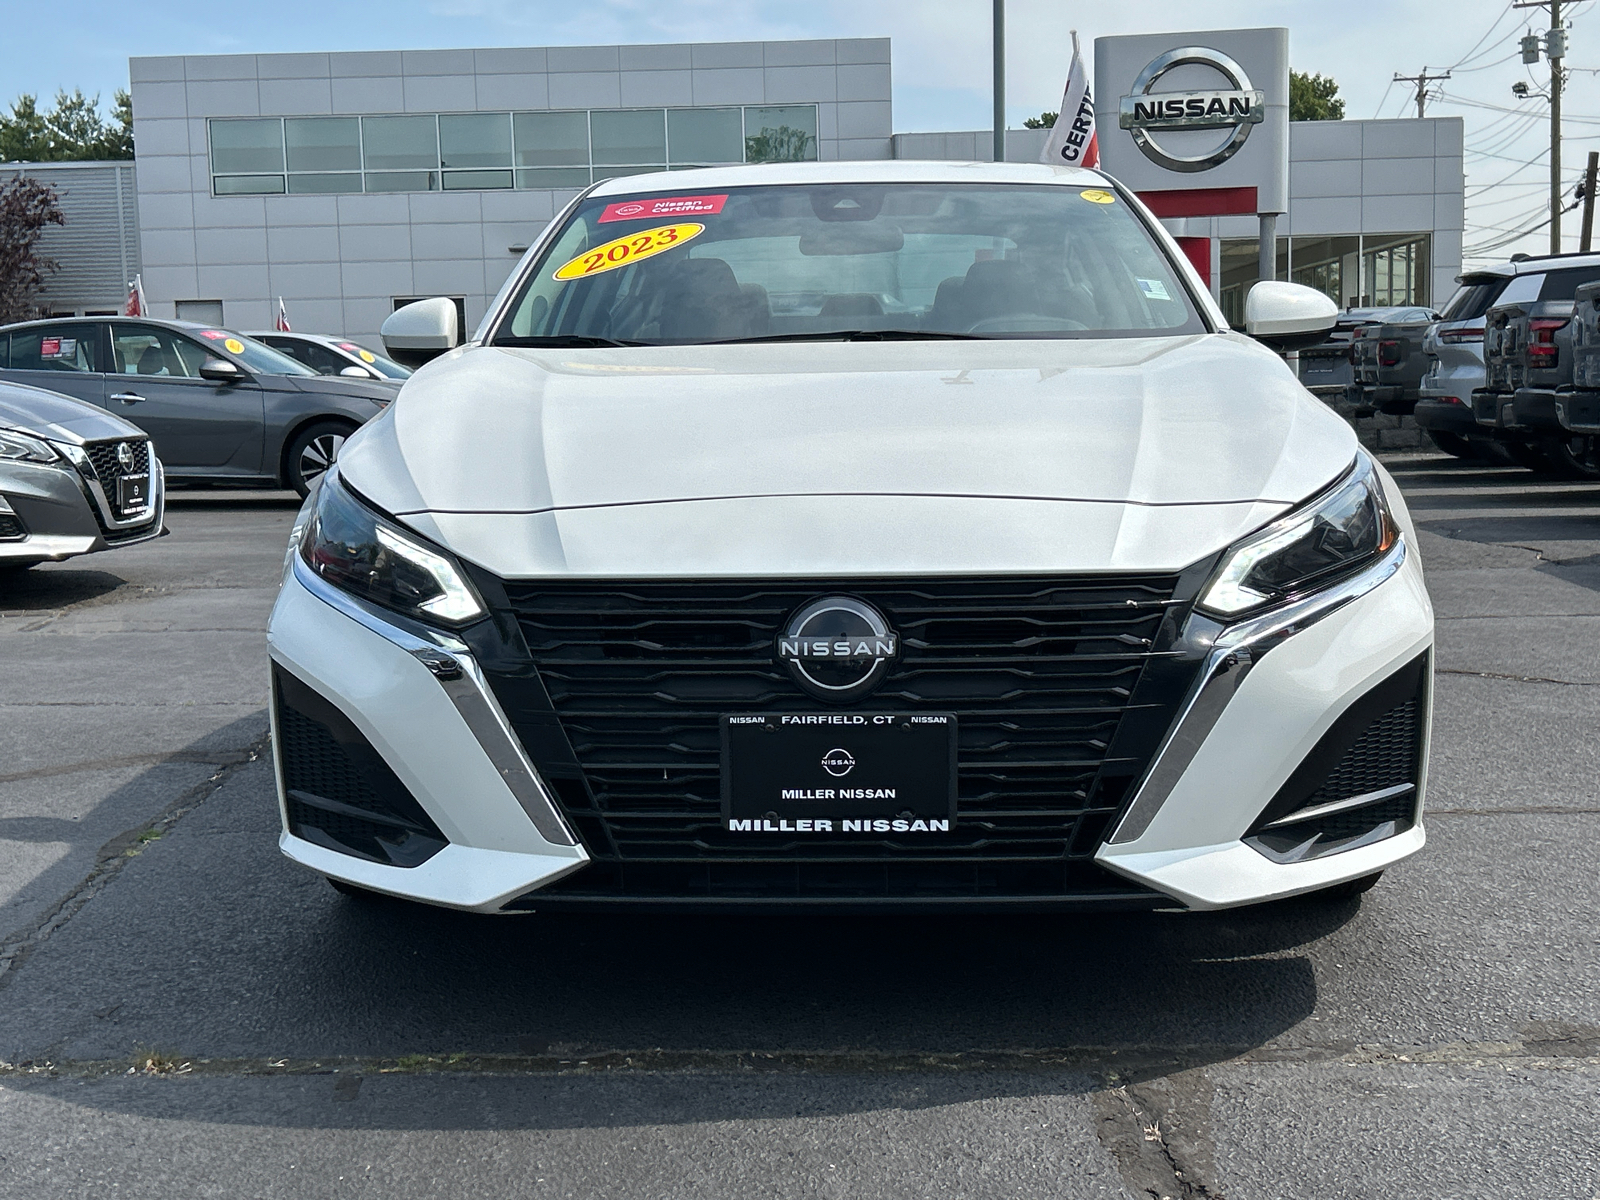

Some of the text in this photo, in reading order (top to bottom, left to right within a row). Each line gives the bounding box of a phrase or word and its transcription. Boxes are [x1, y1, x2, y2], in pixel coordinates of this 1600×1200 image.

[1134, 97, 1250, 121] NISSAN
[651, 204, 713, 213] Certified
[654, 200, 702, 208] Nissan
[583, 228, 678, 274] 2023
[781, 640, 894, 656] NISSAN
[729, 715, 947, 725] NISSAN FAIRFIELD, CT NISSAN
[781, 789, 896, 799] MILLER NISSAN
[729, 819, 949, 832] MILLER NISSAN
